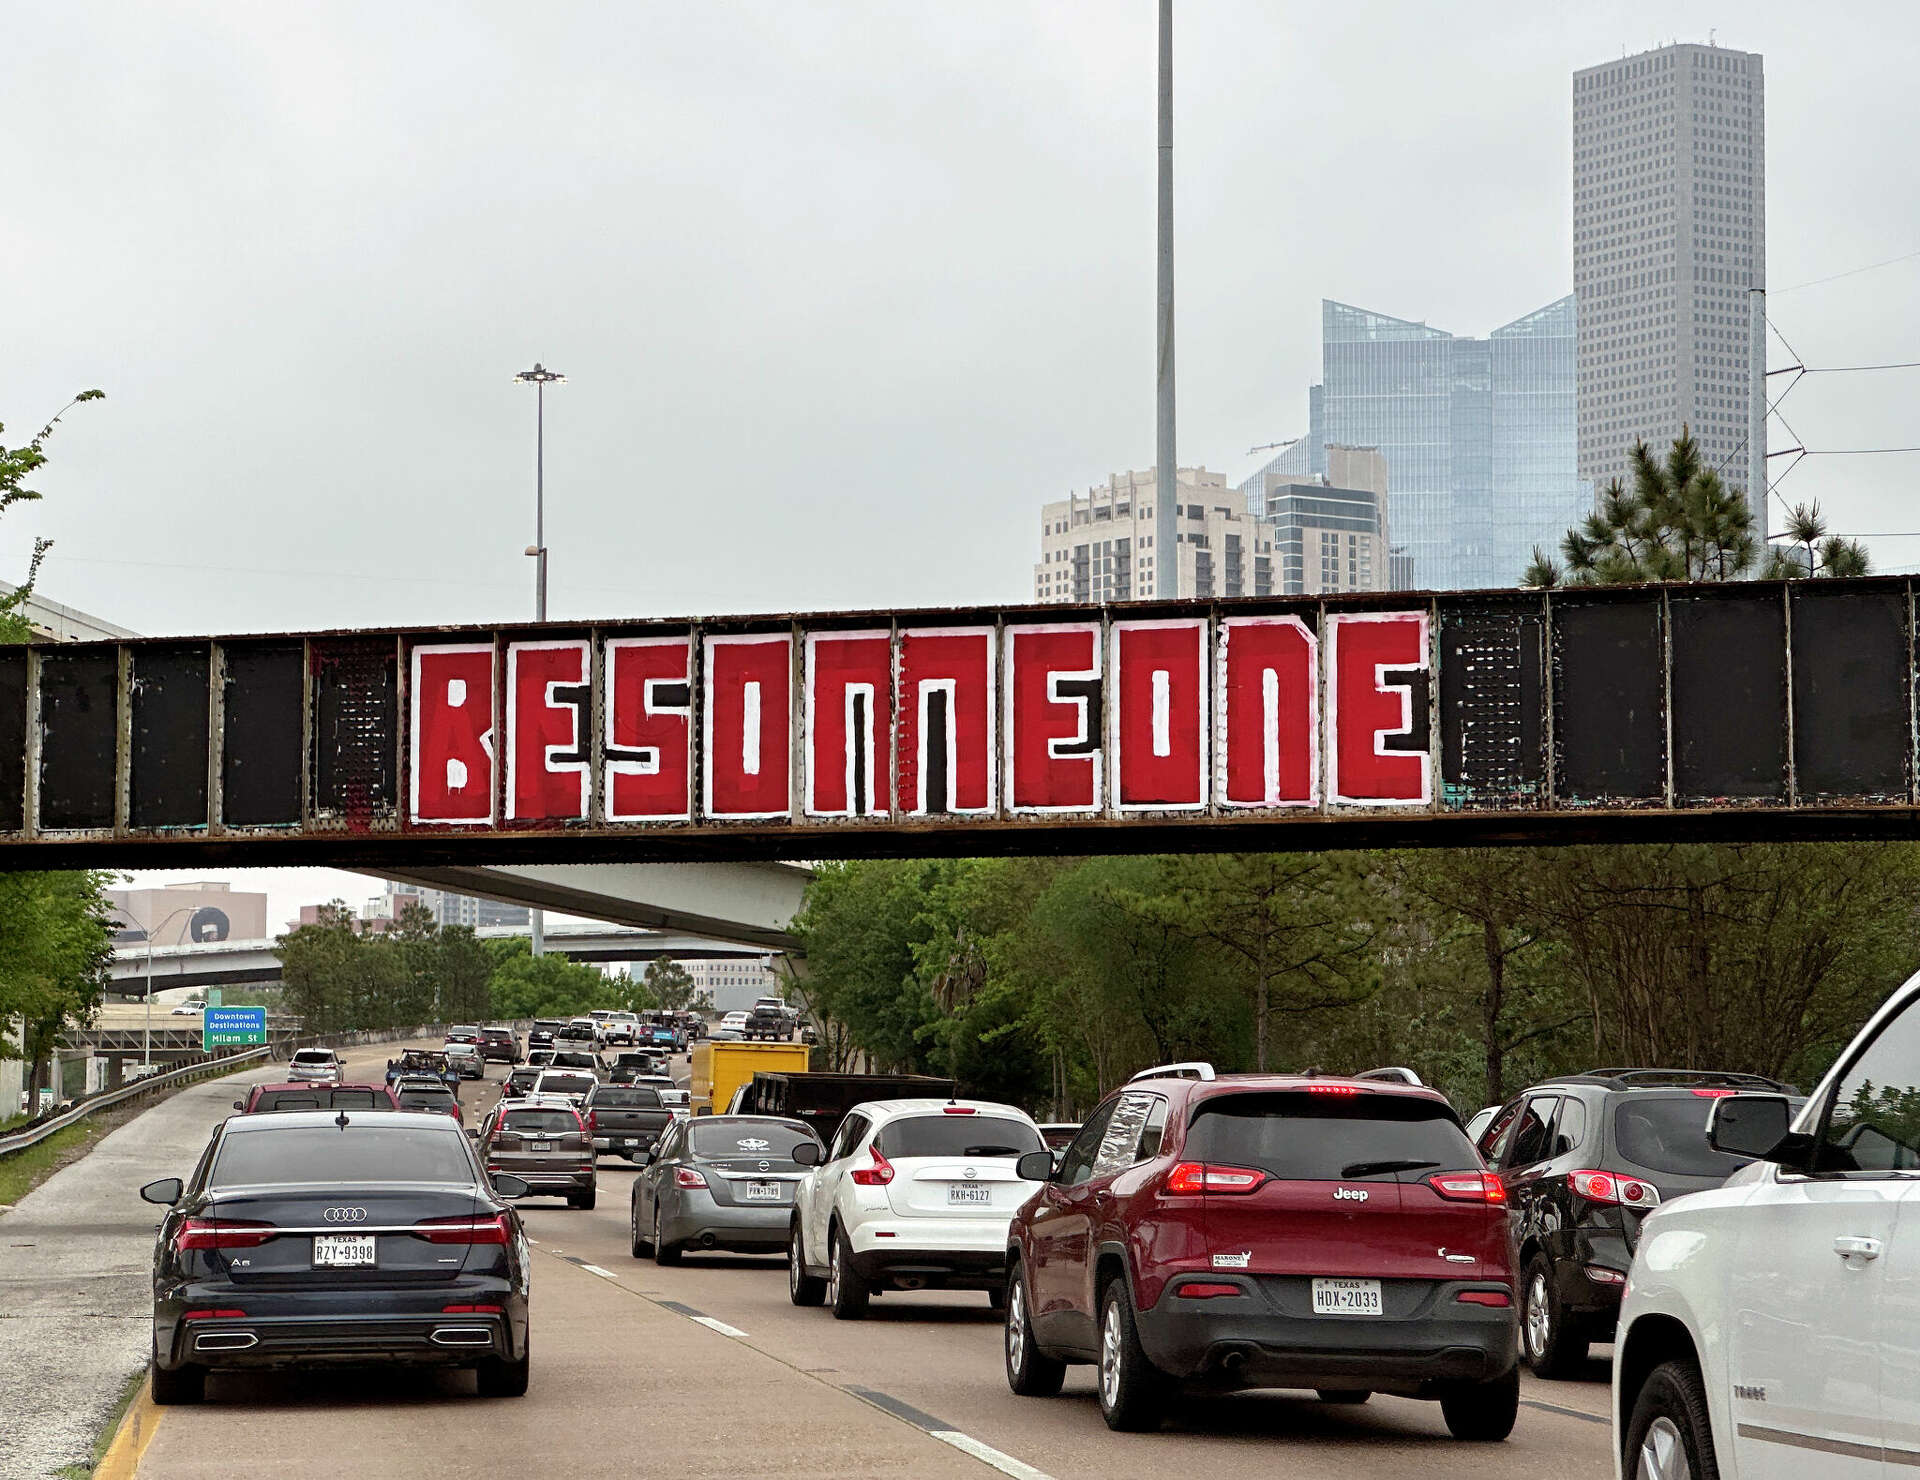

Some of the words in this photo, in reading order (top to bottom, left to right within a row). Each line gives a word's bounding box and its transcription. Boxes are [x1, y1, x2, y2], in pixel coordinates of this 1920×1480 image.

[212, 1034, 240, 1042] Milam
[247, 1034, 257, 1042] St
[1333, 1187, 1369, 1202] Jeep
[1333, 1281, 1360, 1289] TEXAS
